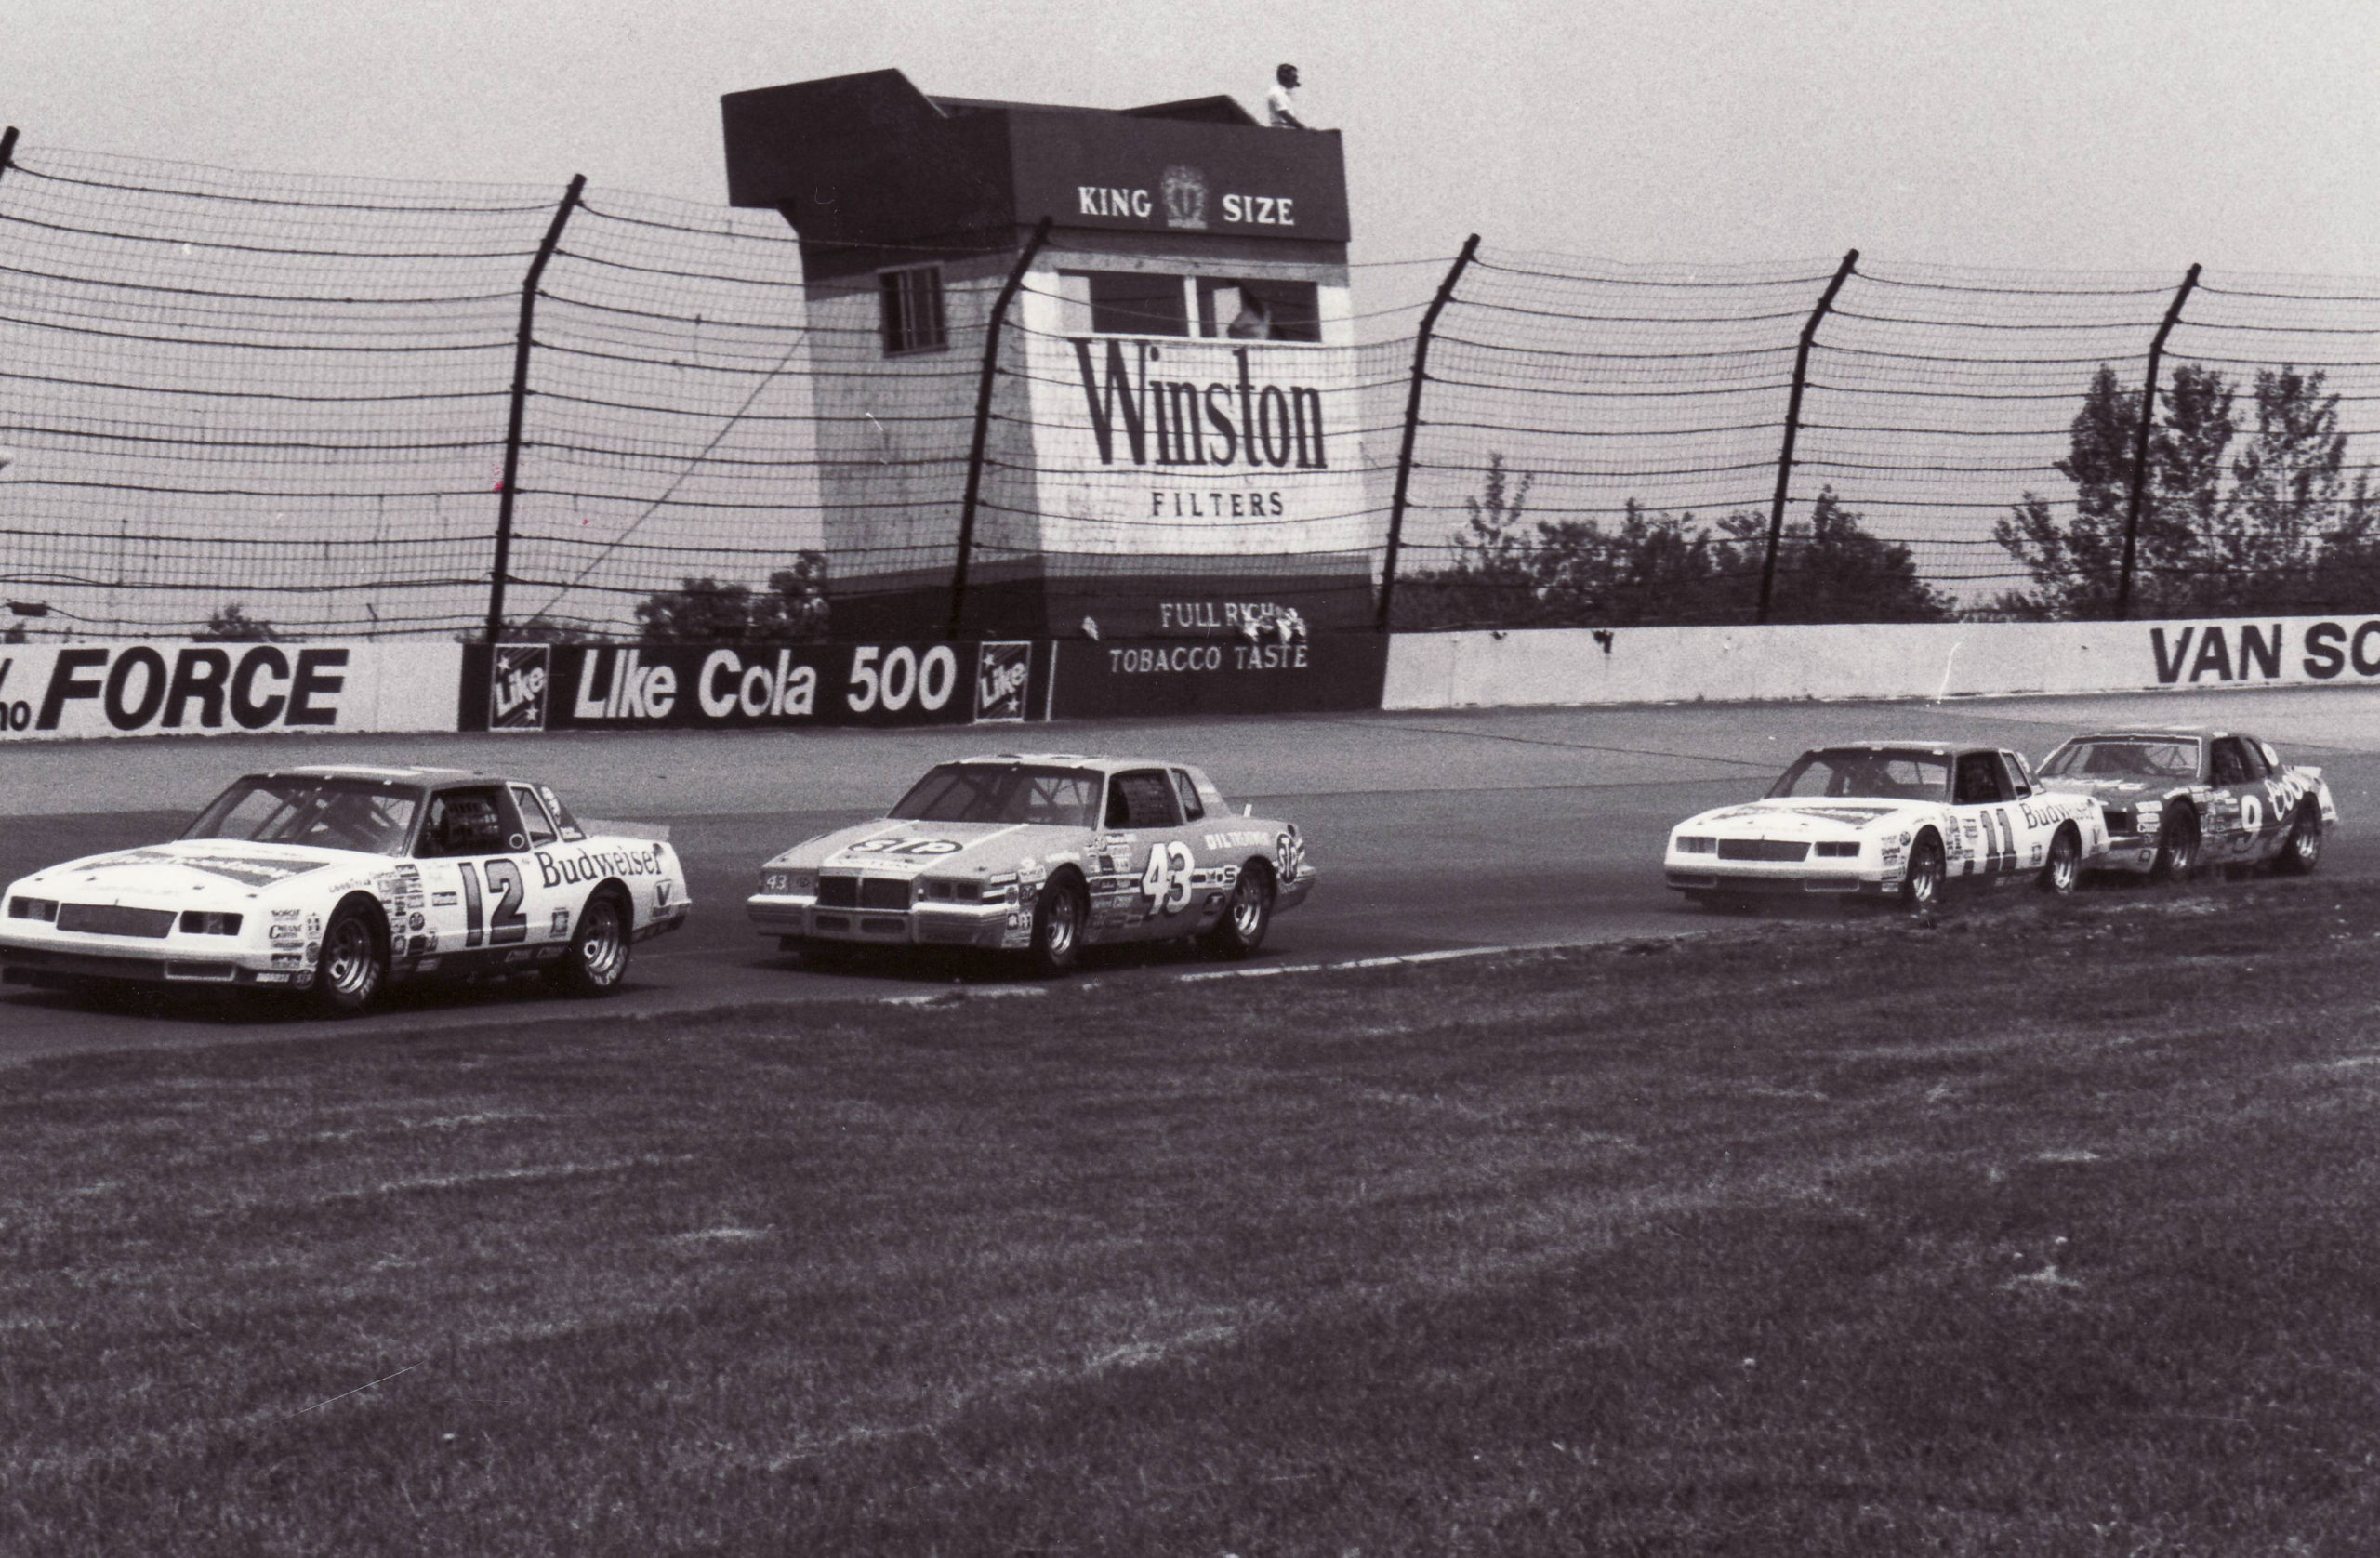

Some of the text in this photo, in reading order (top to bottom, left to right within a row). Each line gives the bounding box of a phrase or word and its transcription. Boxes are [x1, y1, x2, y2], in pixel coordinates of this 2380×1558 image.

[1078, 187, 1294, 225] KING SIZE
[1066, 337, 1328, 469] Winston
[1152, 491, 1284, 517] FILTERS
[1161, 602, 1221, 627] FULL
[698, 648, 817, 717] Cola
[847, 645, 956, 712] 500
[1109, 644, 1308, 673] TOBACCO TASTE
[2149, 623, 2282, 684] VAN
[35, 646, 350, 731] FORCE
[494, 666, 546, 717] Like
[982, 661, 1026, 709] Like
[1979, 808, 2016, 871] 11
[2233, 794, 2263, 853] 9
[534, 844, 664, 889] Budweiser
[766, 875, 788, 891] 43
[1142, 840, 1195, 917] 43
[458, 859, 527, 947] 12
